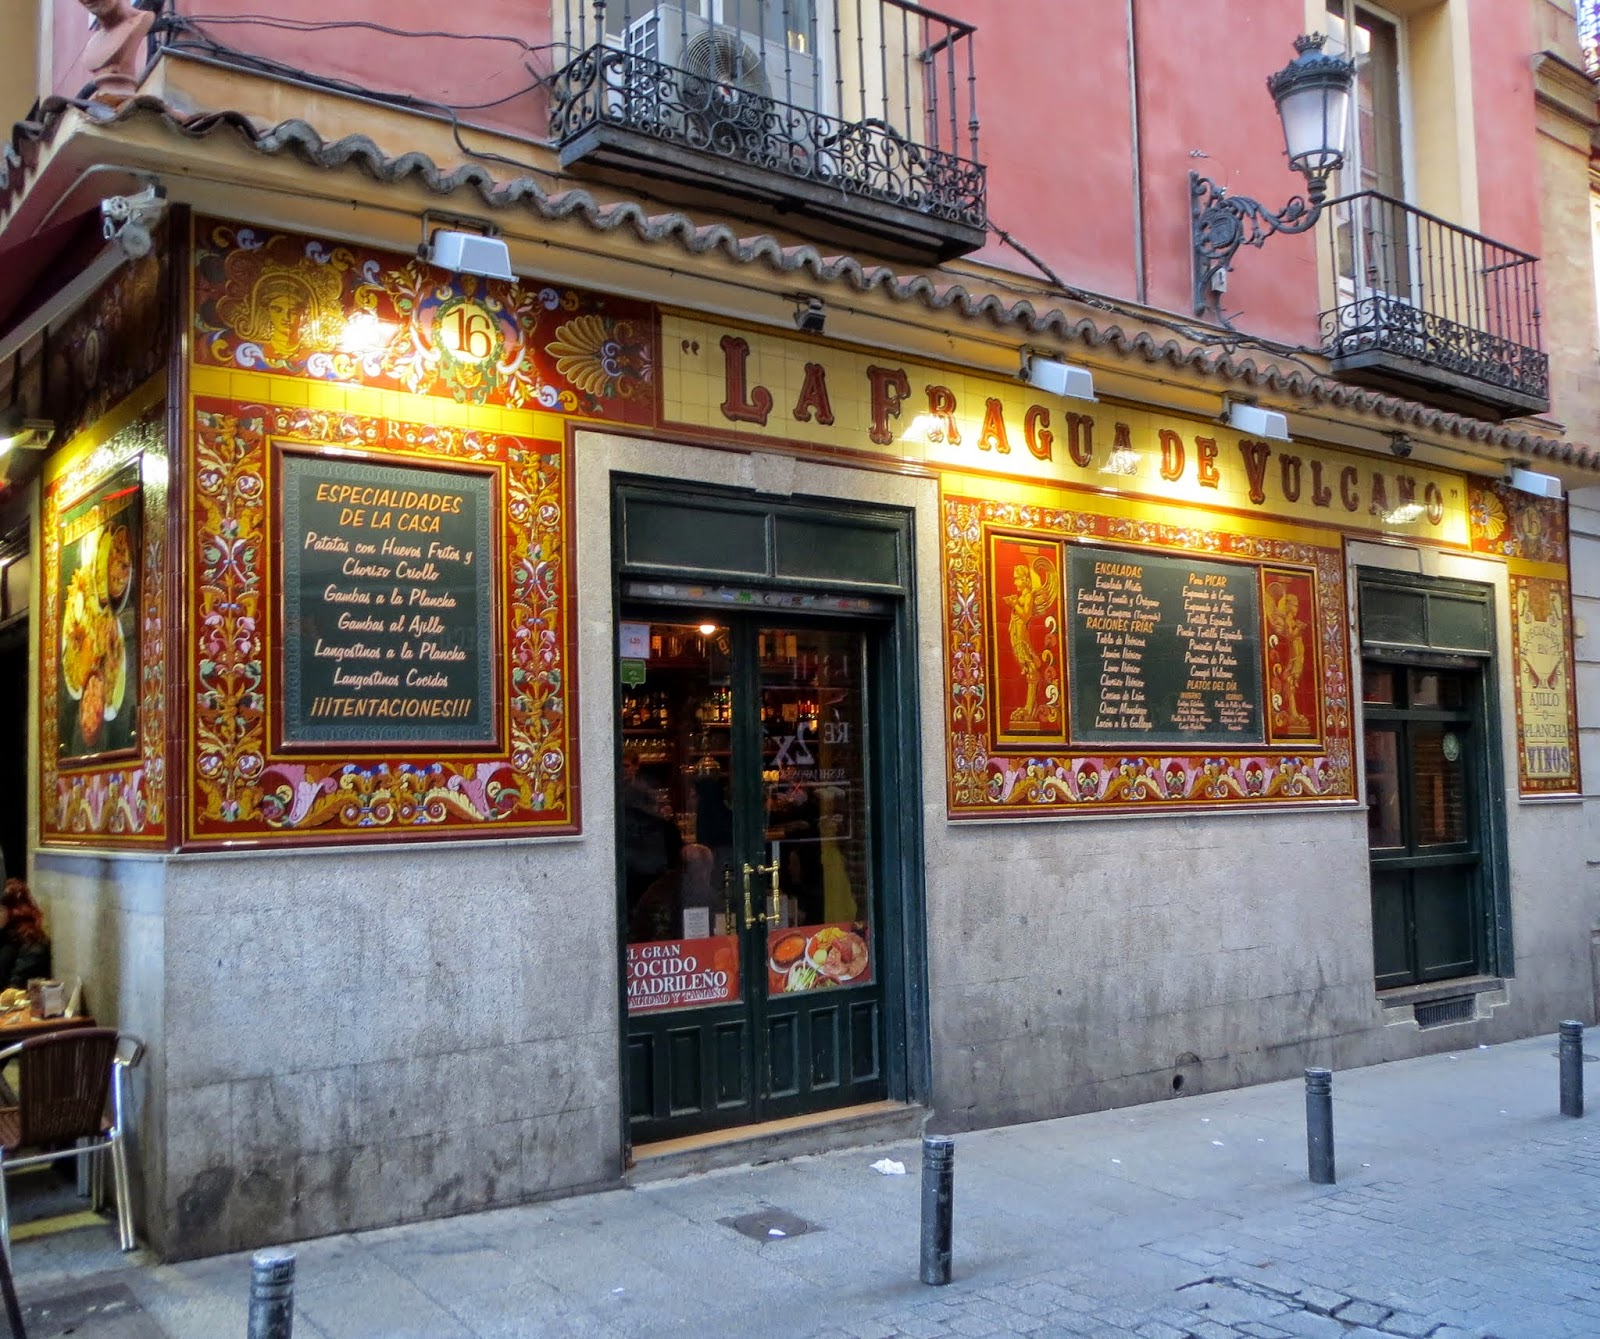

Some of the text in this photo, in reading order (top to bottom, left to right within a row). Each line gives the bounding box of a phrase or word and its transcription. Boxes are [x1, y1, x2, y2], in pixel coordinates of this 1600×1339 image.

[446, 308, 492, 358] 16
[866, 364, 1138, 476] FRAGUA
[1158, 428, 1221, 490] DE
[316, 483, 464, 515] ESPECIALIDADES
[339, 508, 442, 534] DE LA CASA
[304, 531, 474, 566] Patatas con Huevos Fritos y
[342, 557, 440, 582] Chorizo Criollo
[1094, 562, 1143, 578] ENSALADAS
[1204, 574, 1228, 587] PICAR
[324, 583, 457, 608] Gambas a la Plancha
[337, 611, 446, 639] Gambas al Ajillo
[1086, 616, 1129, 632] RACIONES
[314, 638, 468, 663] Langostinos a la Plancha
[333, 666, 449, 690] Langostinos Cocidos
[1529, 692, 1560, 710] AJILLO
[1524, 723, 1568, 738] PLANCHA
[1527, 745, 1570, 773] VINOS
[642, 944, 681, 959] GRAN
